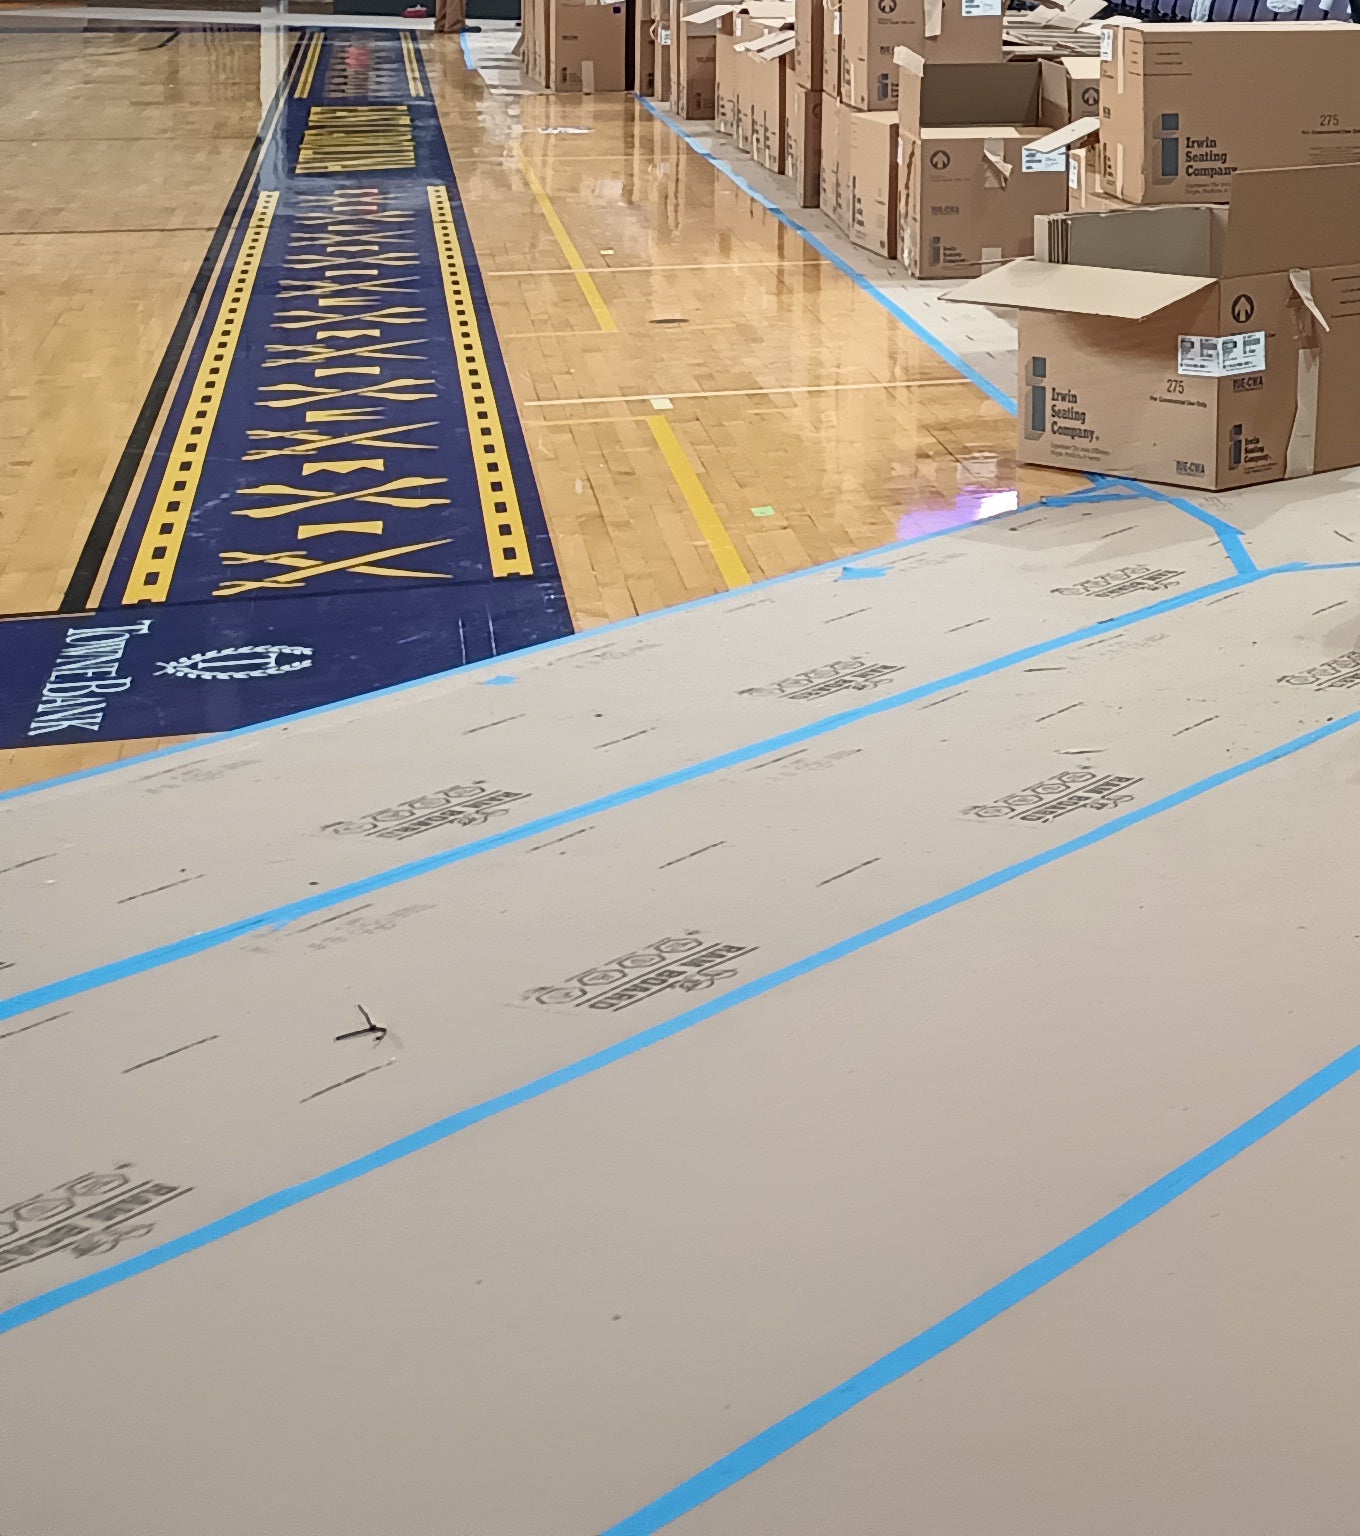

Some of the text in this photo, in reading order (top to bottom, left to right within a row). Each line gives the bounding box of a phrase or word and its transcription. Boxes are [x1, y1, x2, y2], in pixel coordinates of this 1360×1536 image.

[1319, 114, 1340, 127] 275
[1185, 137, 1217, 149] Irwin
[1185, 151, 1228, 164] Seating
[1185, 165, 1238, 178] Company
[1166, 378, 1185, 395] 275
[1051, 387, 1078, 404] Irwin
[1050, 404, 1086, 425] Seating
[1020, 776, 1135, 821] RAM BOARD
[587, 944, 747, 1010] RAM BOARD
